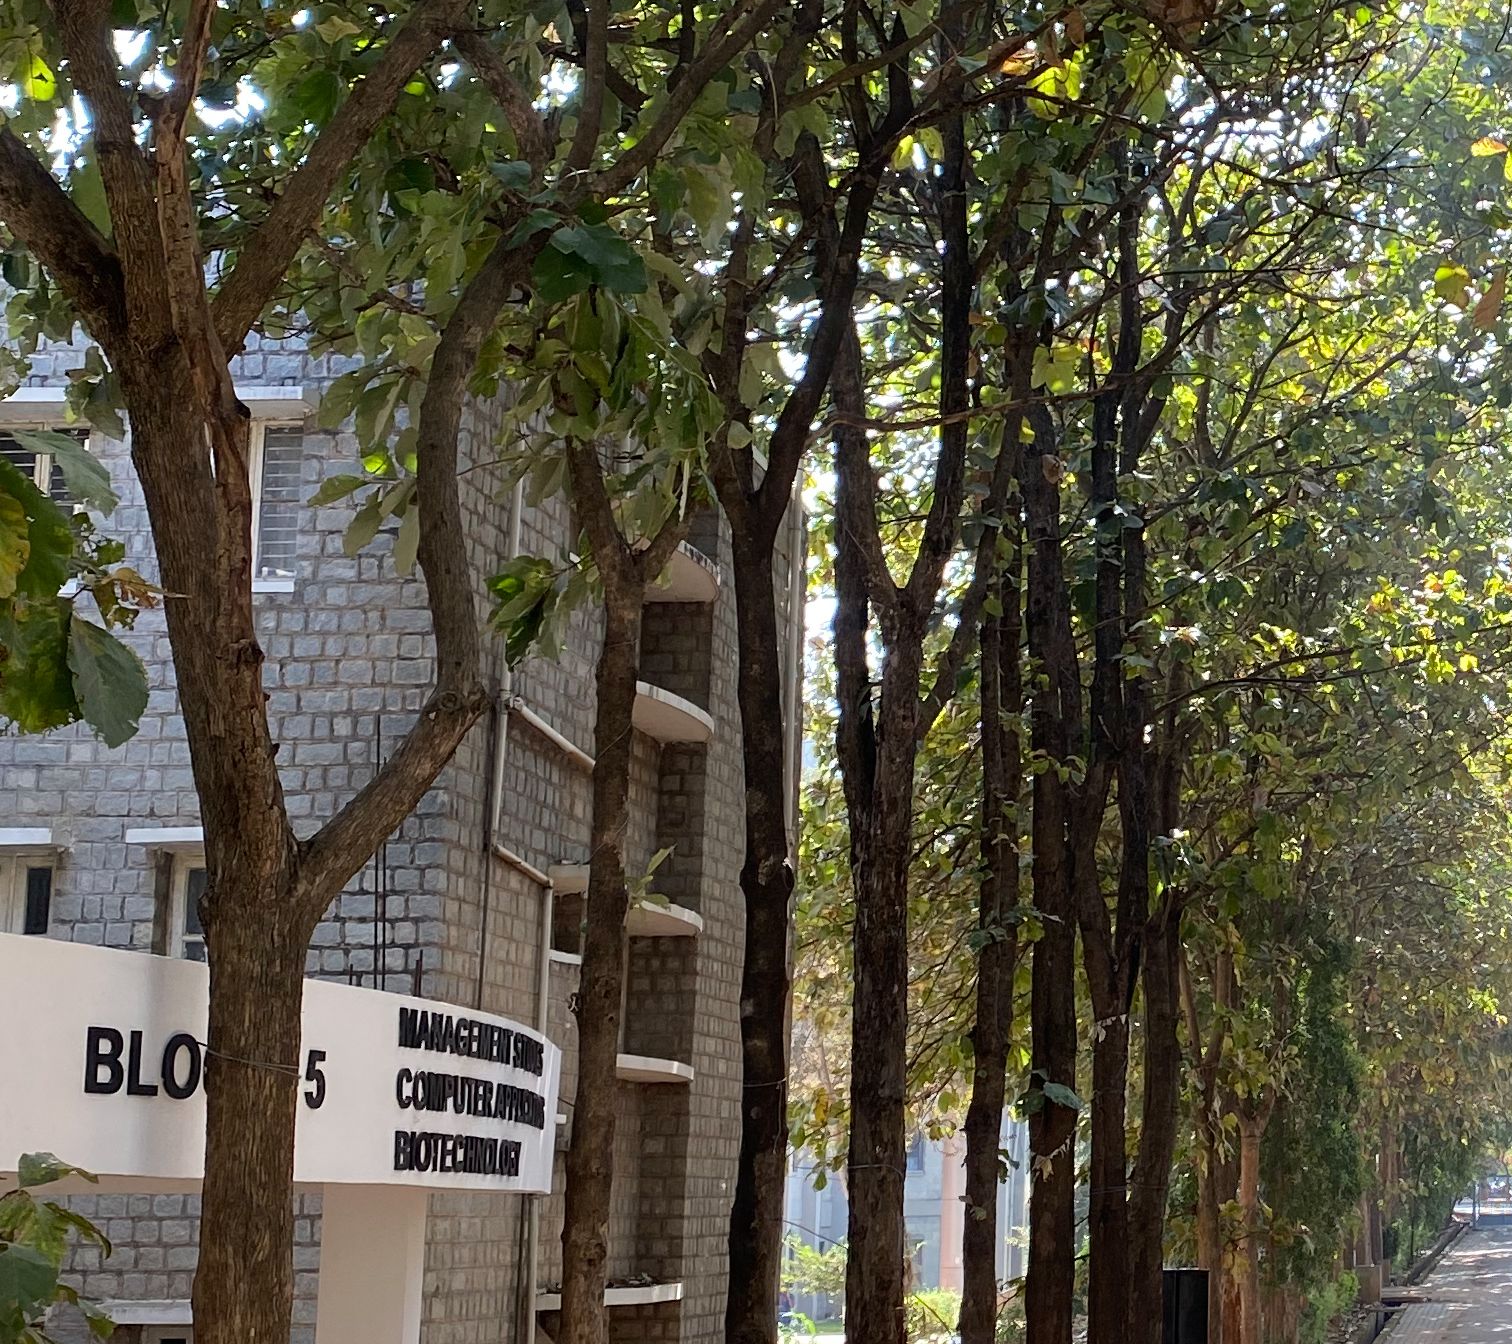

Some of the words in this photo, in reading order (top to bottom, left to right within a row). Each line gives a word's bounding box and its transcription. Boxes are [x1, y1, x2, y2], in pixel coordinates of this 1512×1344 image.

[399, 1007, 514, 1065] MANAGEMENT
[84, 1026, 207, 1100] BLO
[304, 1049, 327, 1110] 5
[397, 1067, 495, 1118] COMPUTER
[394, 1130, 522, 1177] BIOTECHNOLOGY
